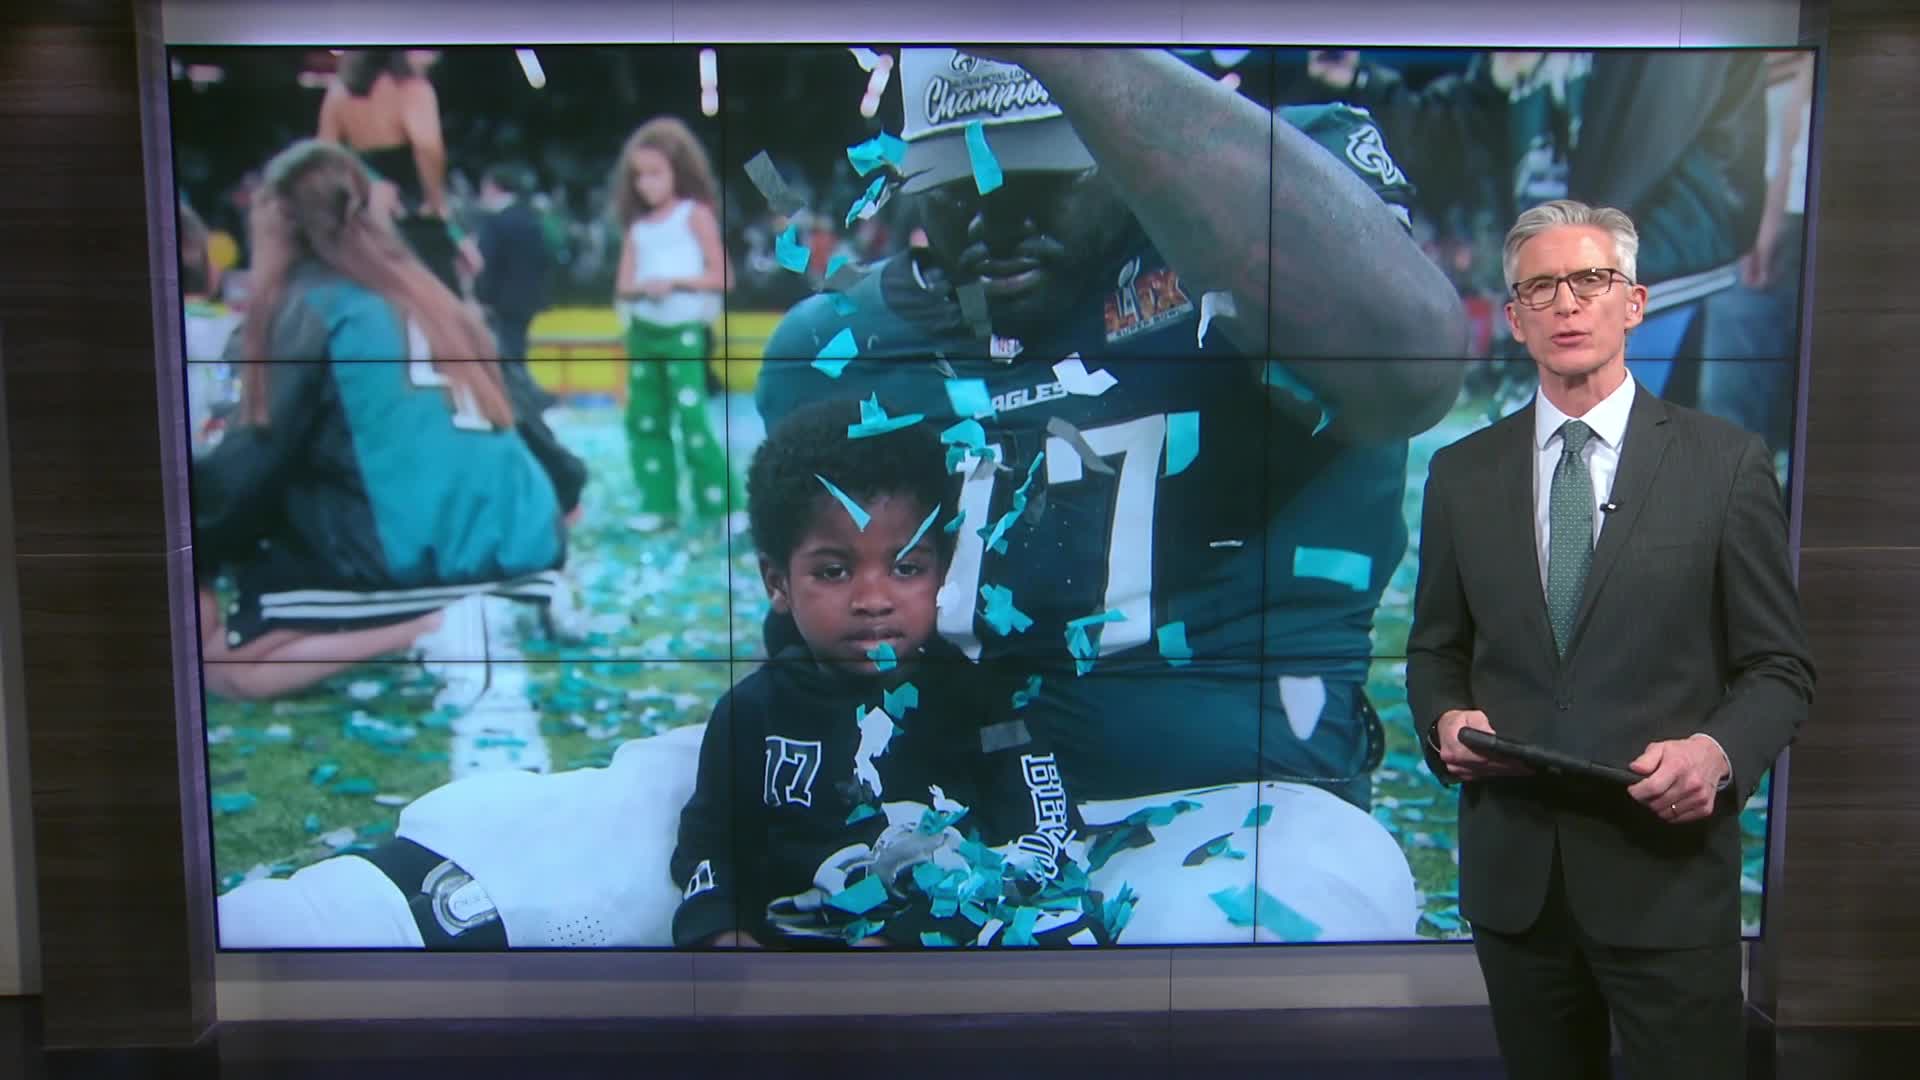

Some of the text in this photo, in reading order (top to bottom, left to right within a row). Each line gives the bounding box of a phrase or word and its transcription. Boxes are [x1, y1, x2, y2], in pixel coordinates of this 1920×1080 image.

[975, 380, 1068, 419] AGLES
[937, 413, 1166, 663] 17
[763, 736, 821, 807] 17
